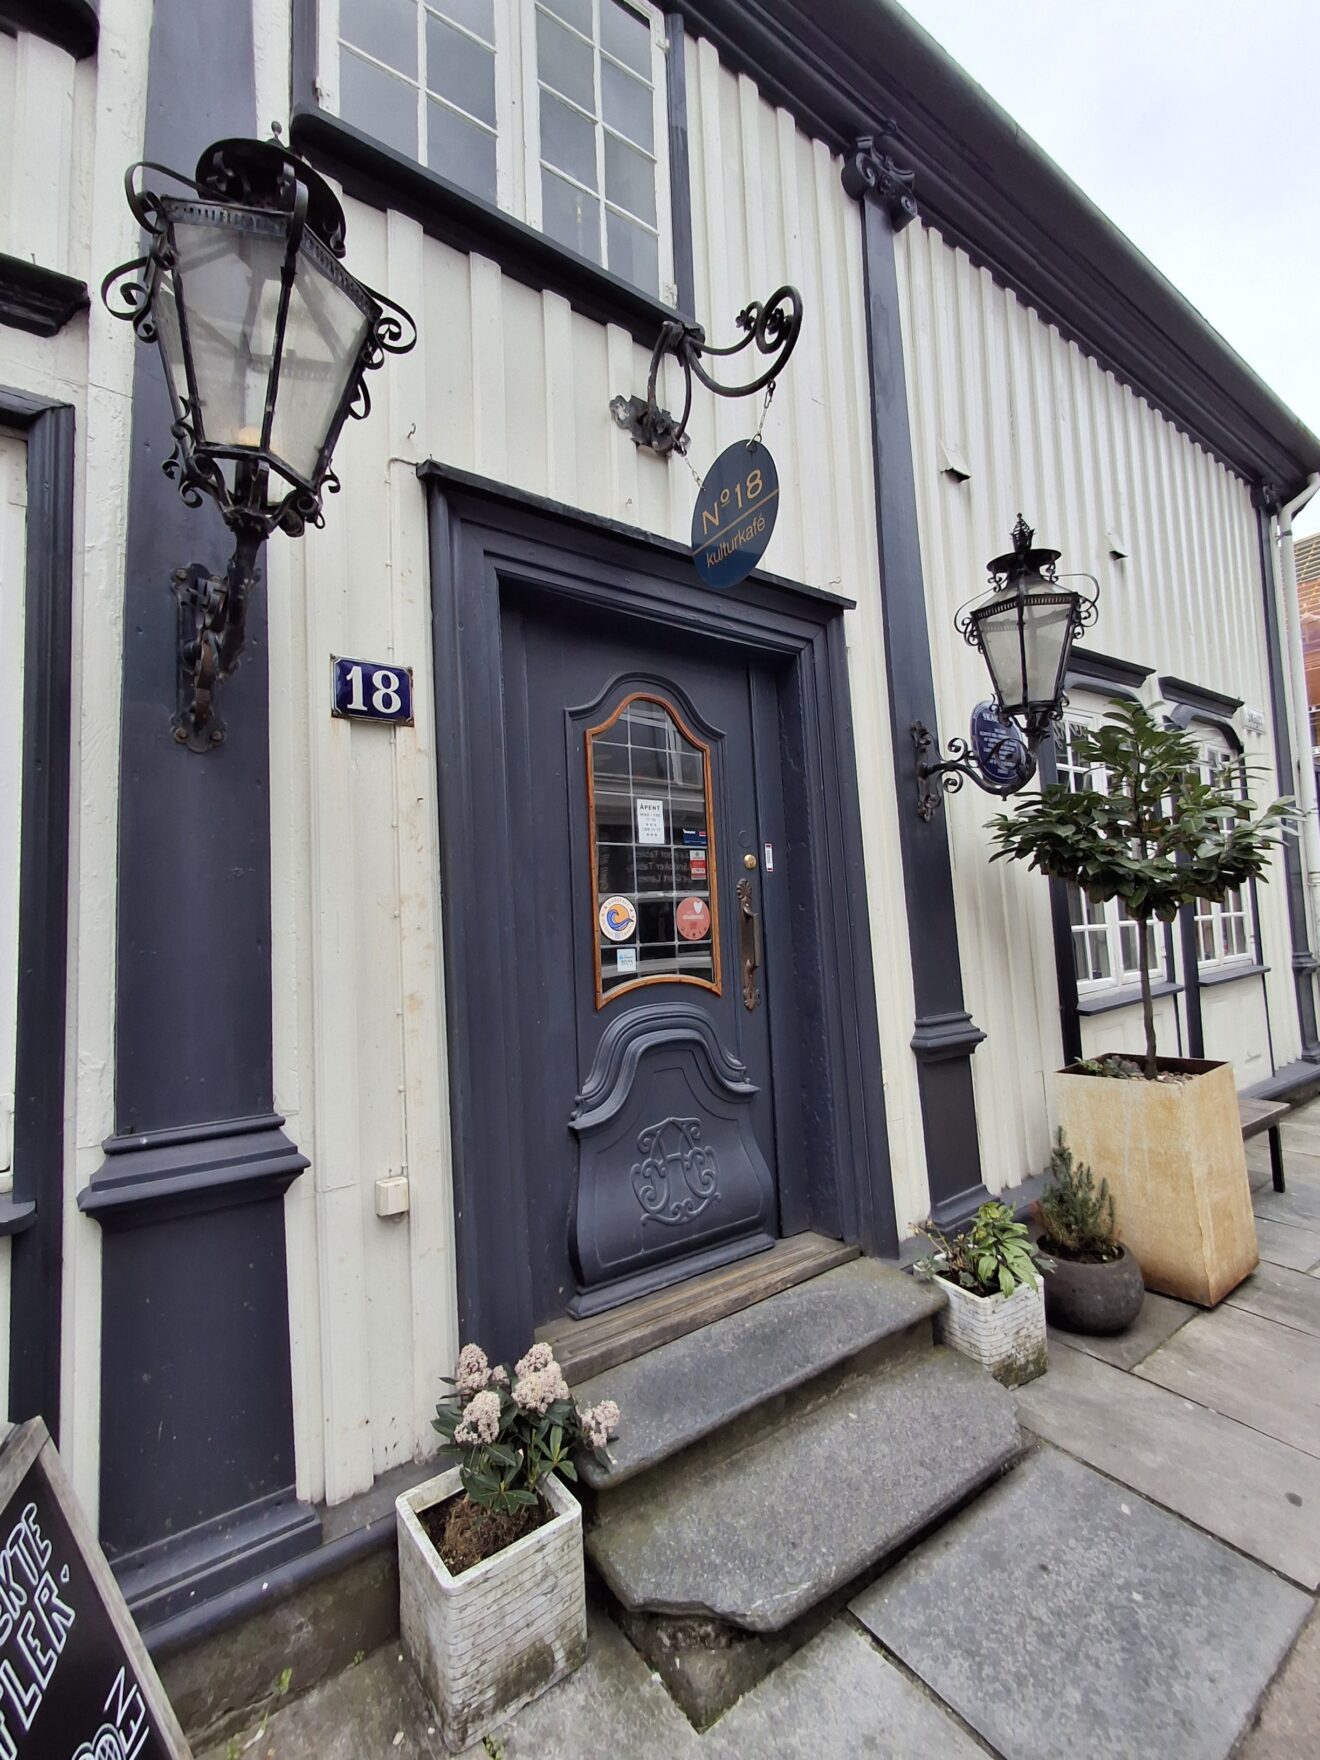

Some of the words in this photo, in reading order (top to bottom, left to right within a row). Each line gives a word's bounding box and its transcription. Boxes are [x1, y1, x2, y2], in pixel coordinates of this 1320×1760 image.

[706, 513, 766, 569] kulturkafé
[346, 665, 402, 714] 18
[639, 803, 661, 811] ÅPENT
